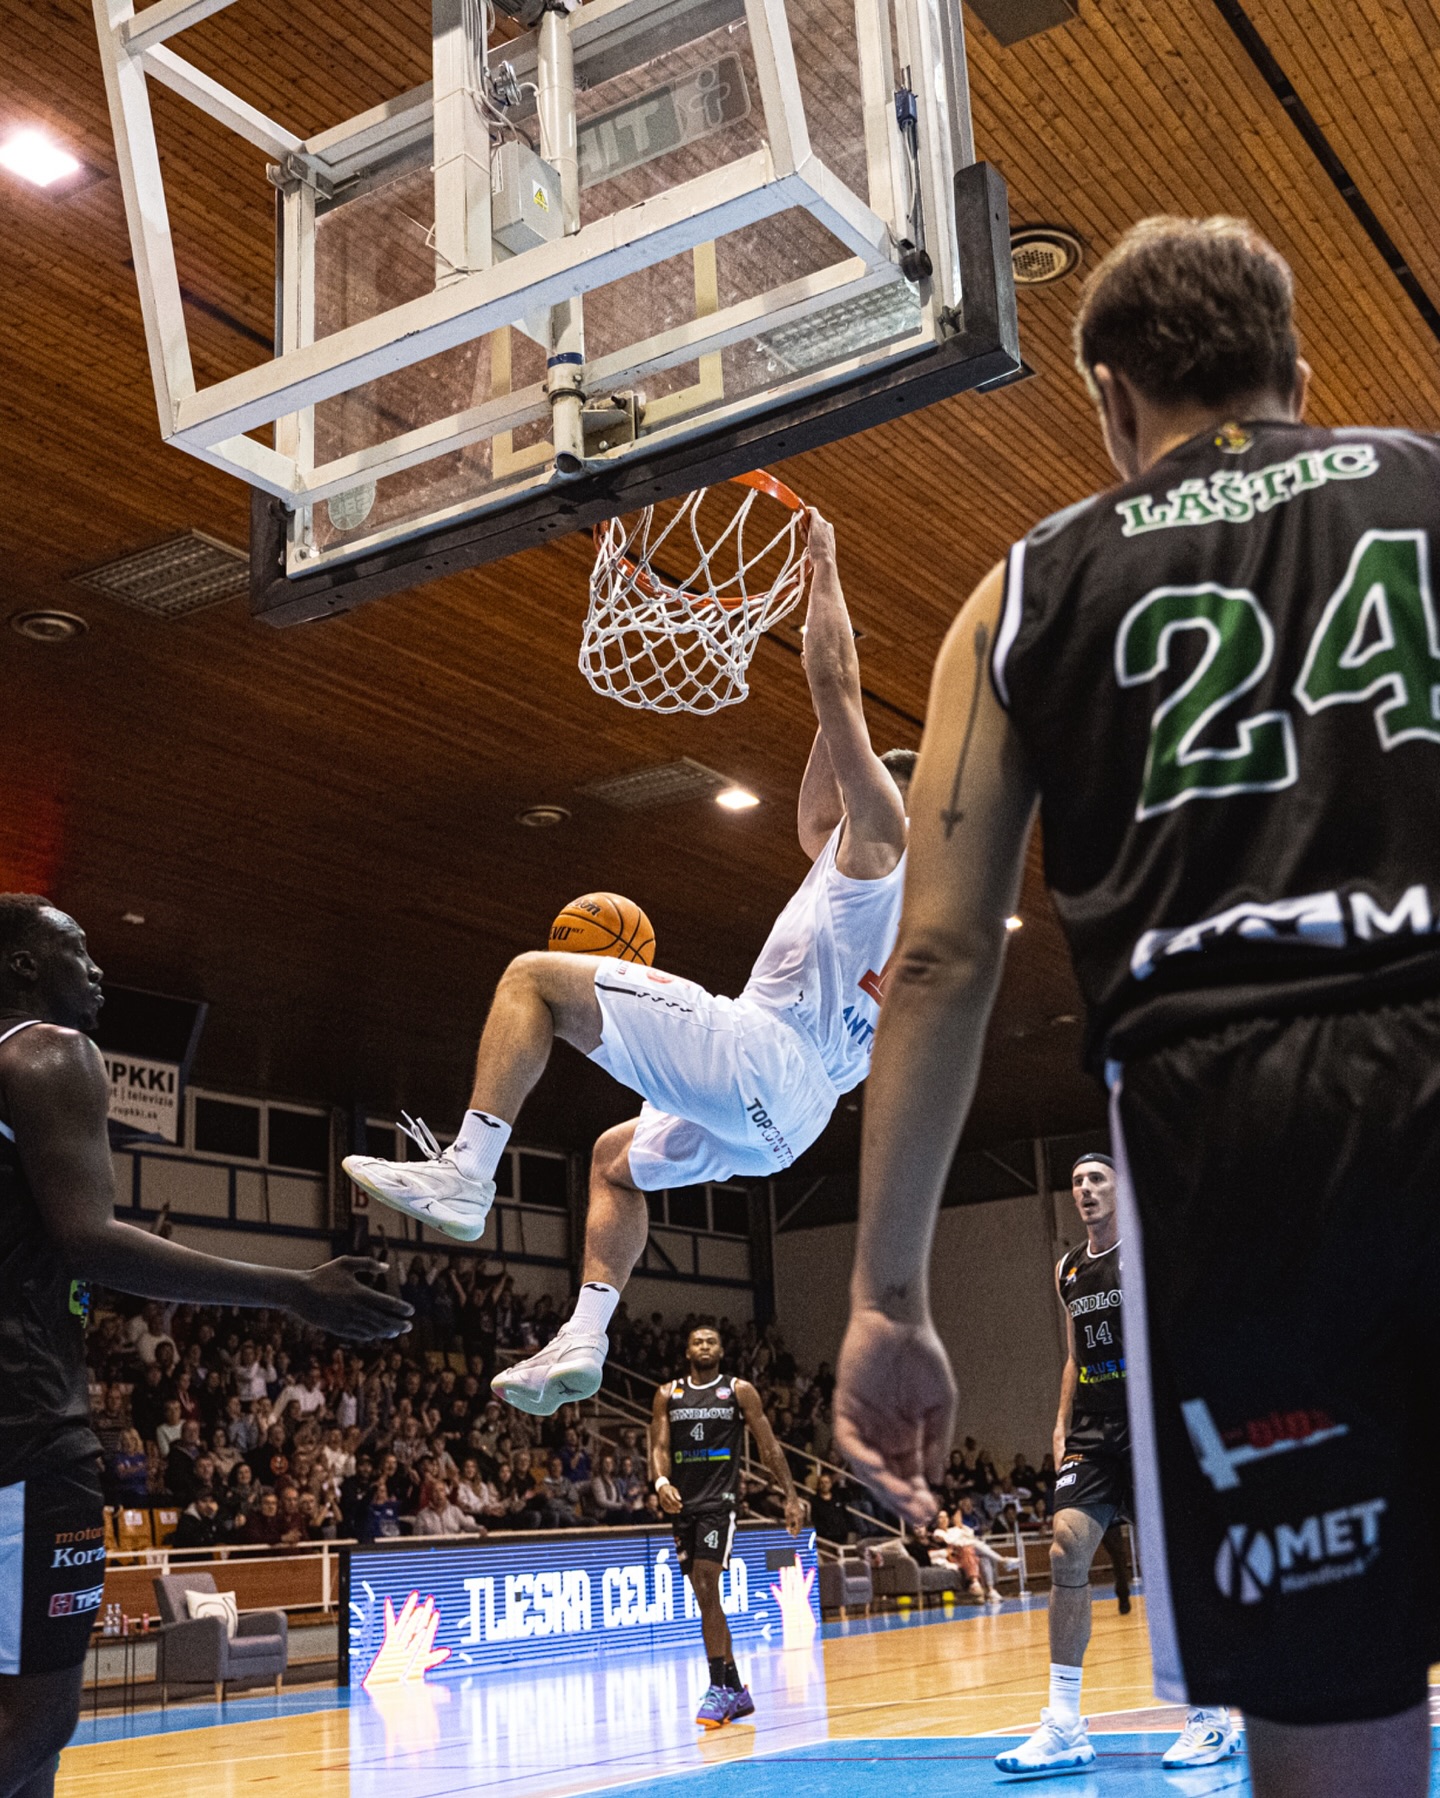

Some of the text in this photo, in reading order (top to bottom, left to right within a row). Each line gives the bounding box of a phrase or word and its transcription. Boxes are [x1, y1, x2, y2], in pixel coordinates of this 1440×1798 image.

[1115, 529, 1440, 823] 24
[1084, 1321, 1113, 1349] 14
[690, 1422, 704, 1441] 4
[703, 1529, 719, 1549] 4
[602, 1548, 674, 1628] CELÁ
[684, 1558, 749, 1619] HLA
